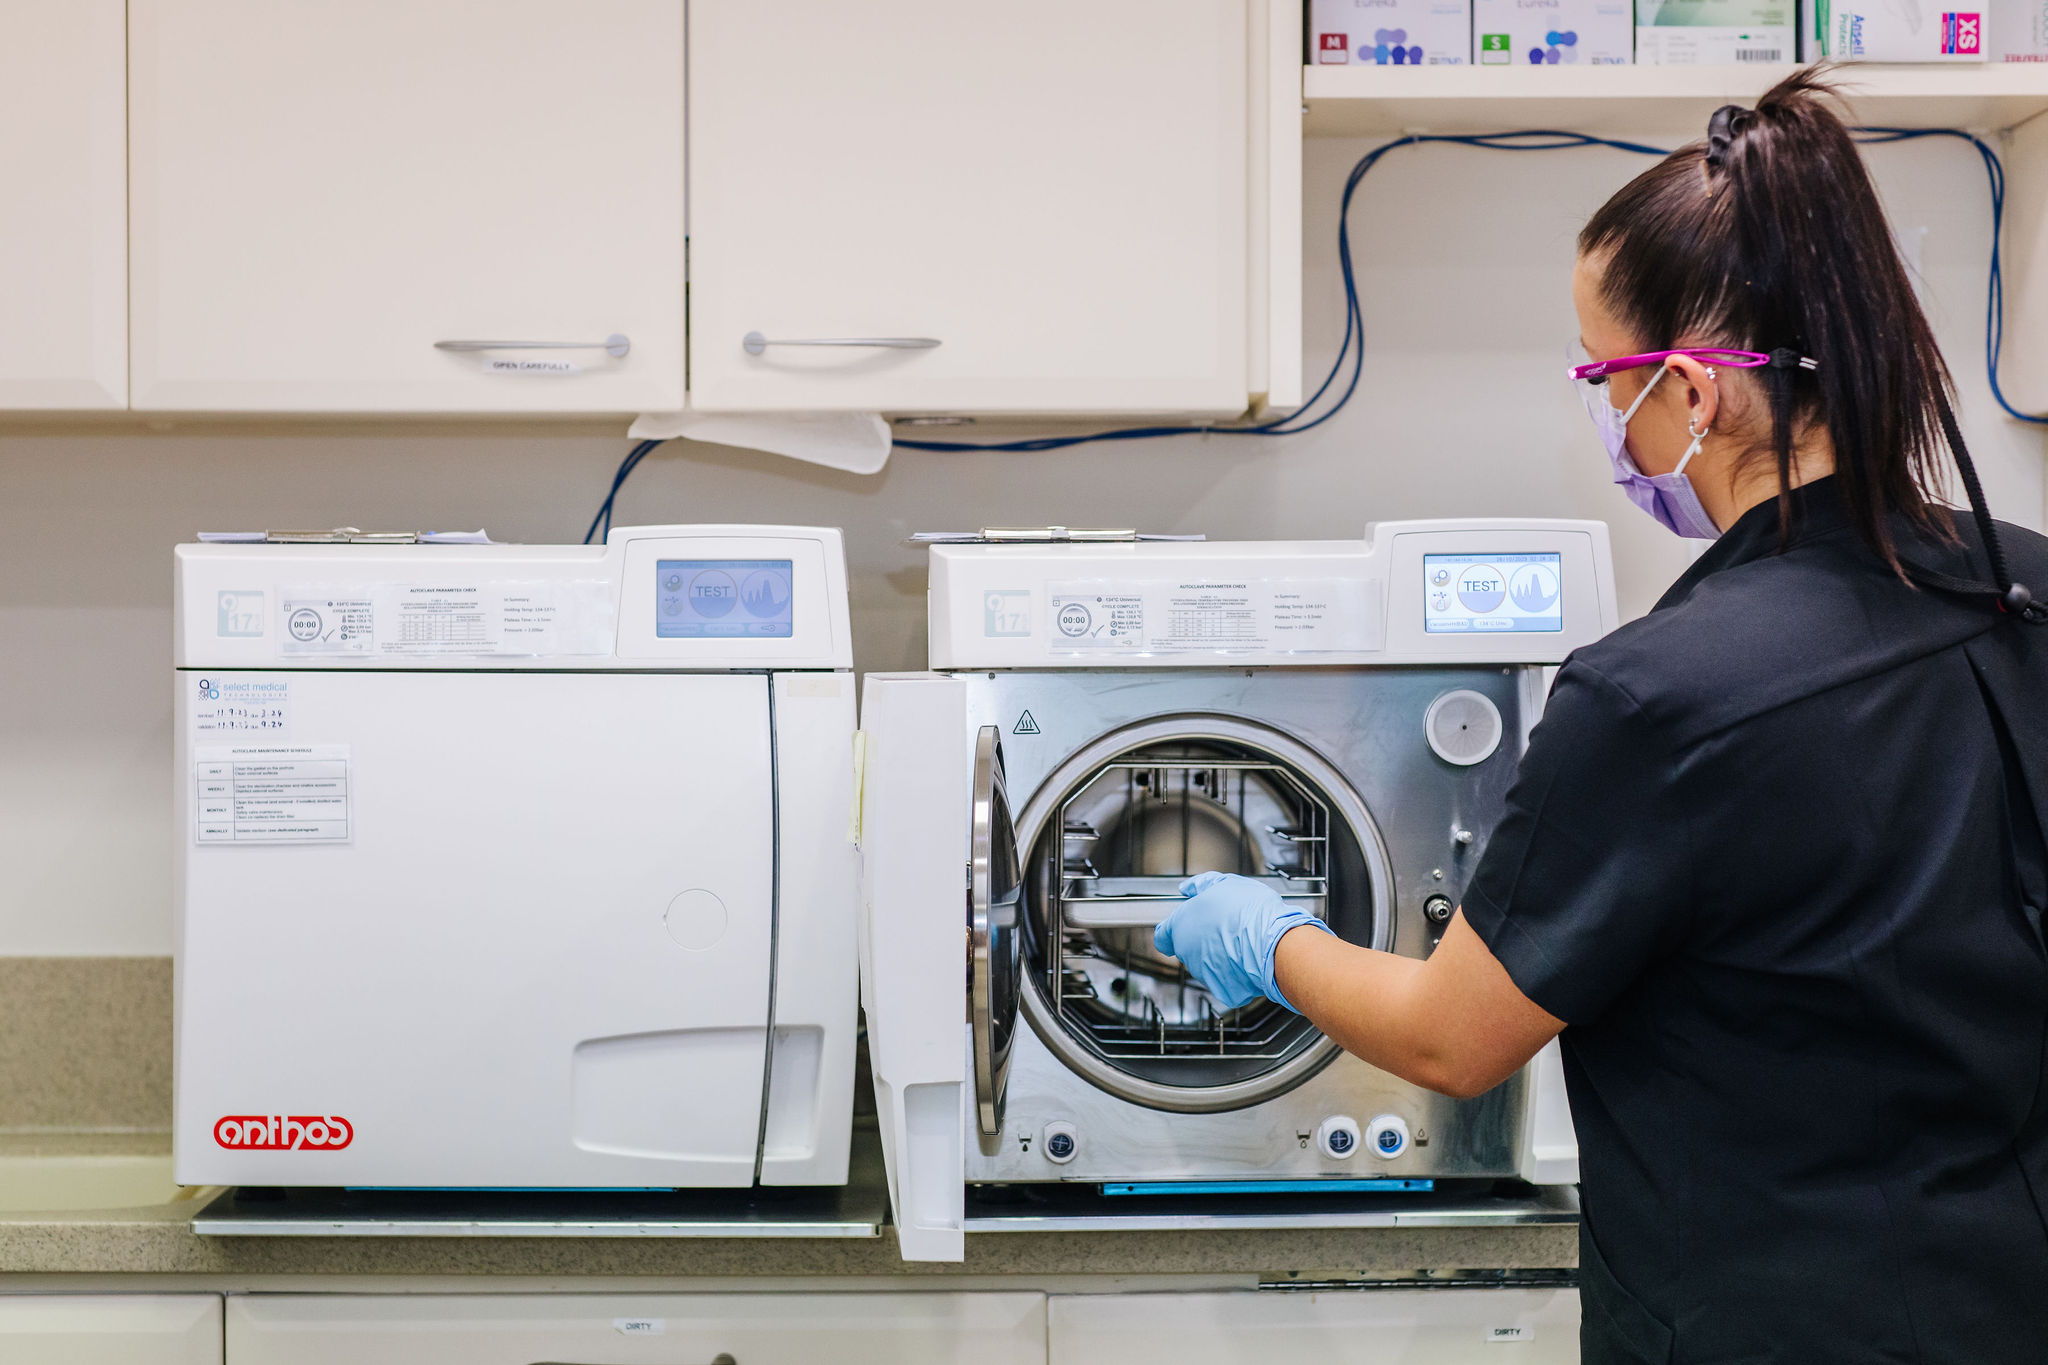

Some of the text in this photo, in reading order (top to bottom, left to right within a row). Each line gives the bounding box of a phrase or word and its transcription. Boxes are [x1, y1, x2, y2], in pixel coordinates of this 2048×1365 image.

[1853, 14, 1865, 56] Ansell
[1958, 18, 1978, 50] XS
[1326, 35, 1341, 49] M
[1490, 36, 1502, 50] S
[492, 361, 570, 371] OPEN CAREFULLY
[695, 586, 731, 598] TEST
[1463, 580, 1499, 592] TEST
[1062, 616, 1086, 624] 00:00
[223, 682, 288, 691] select medical
[214, 1115, 352, 1151] anthos
[625, 1322, 652, 1331] DIRTY
[1494, 1328, 1522, 1336] DIRTY
